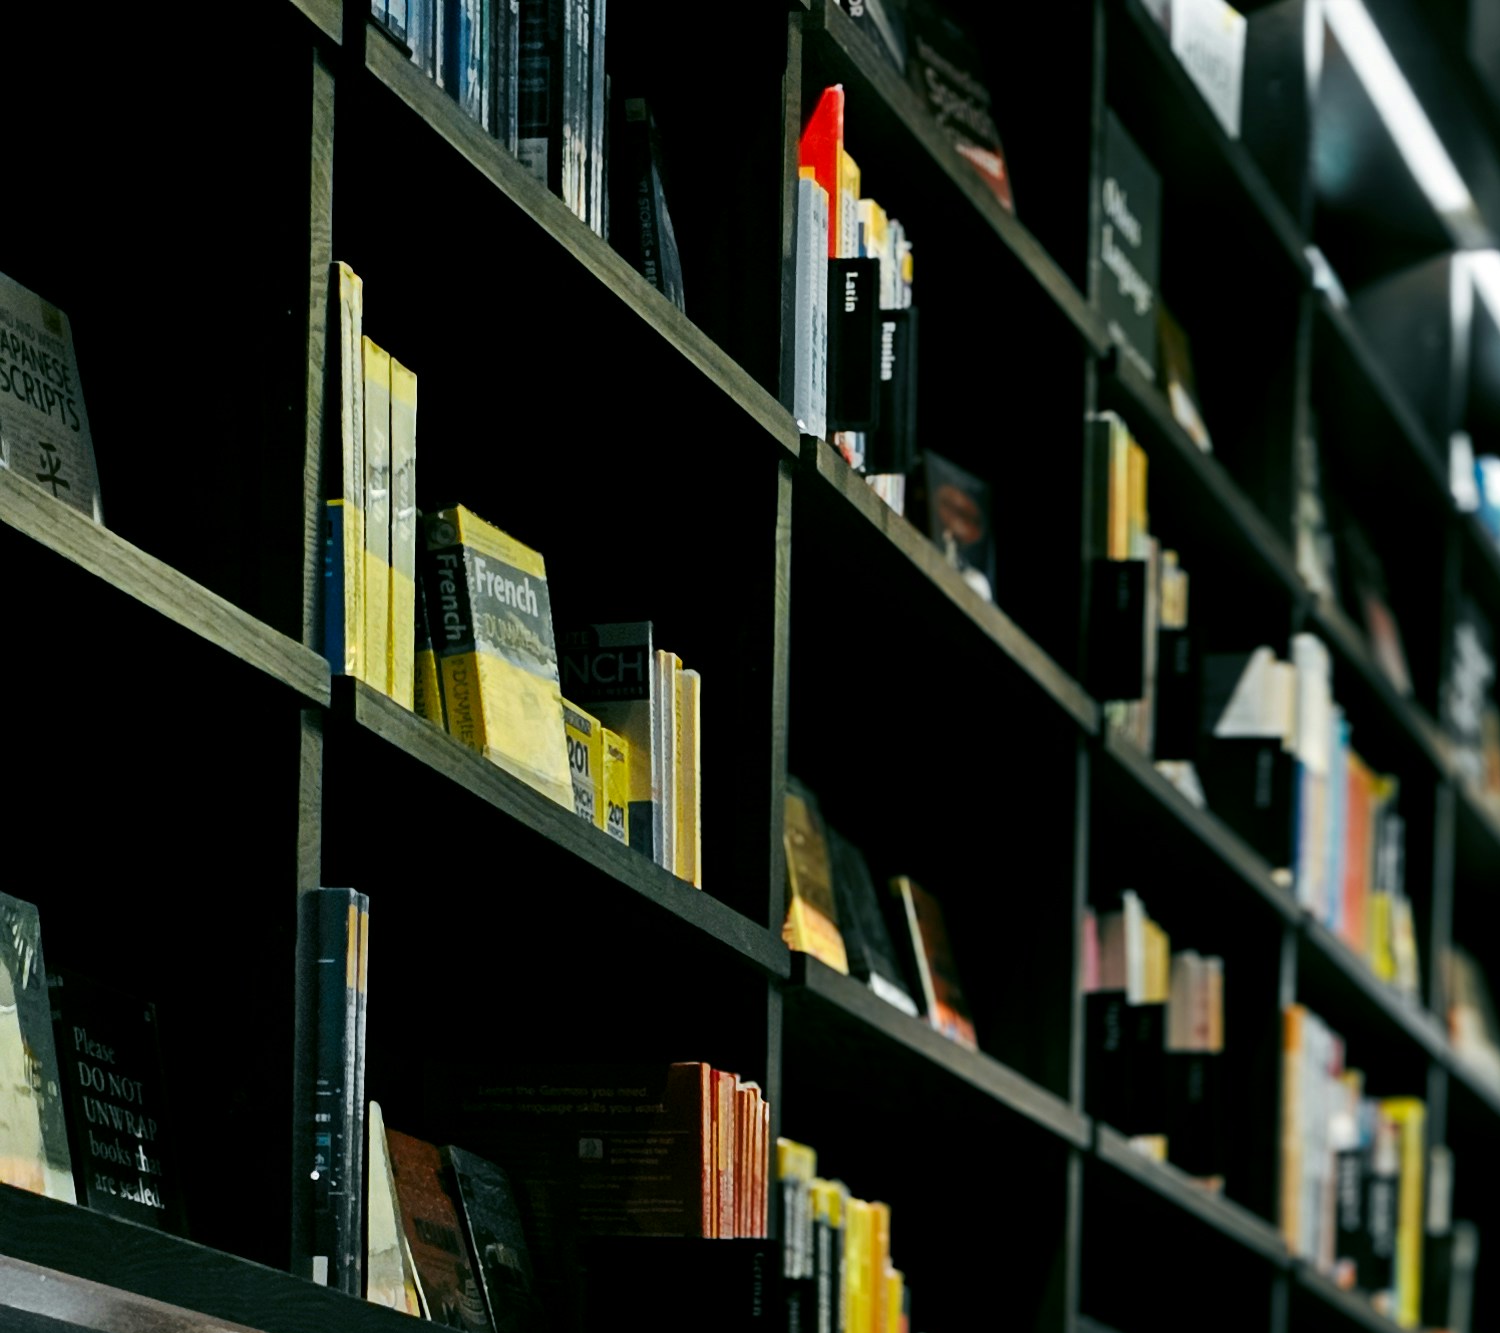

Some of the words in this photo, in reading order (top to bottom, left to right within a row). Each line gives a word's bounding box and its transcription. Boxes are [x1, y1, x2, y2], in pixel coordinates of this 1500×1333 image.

[845, 272, 859, 313] Latin
[881, 322, 897, 381] Russian
[0, 357, 80, 432] SCRIPTS
[436, 553, 467, 642] French
[473, 555, 540, 618] French
[567, 737, 589, 777] 201
[608, 803, 625, 826] 201
[73, 1026, 116, 1064] Please
[78, 1061, 105, 1092] DO
[109, 1072, 144, 1105] NOT
[83, 1096, 158, 1143] UNWRAP
[89, 1130, 132, 1167] books
[135, 1144, 162, 1177] that
[94, 1173, 117, 1195] are
[119, 1178, 166, 1209] sealed.
